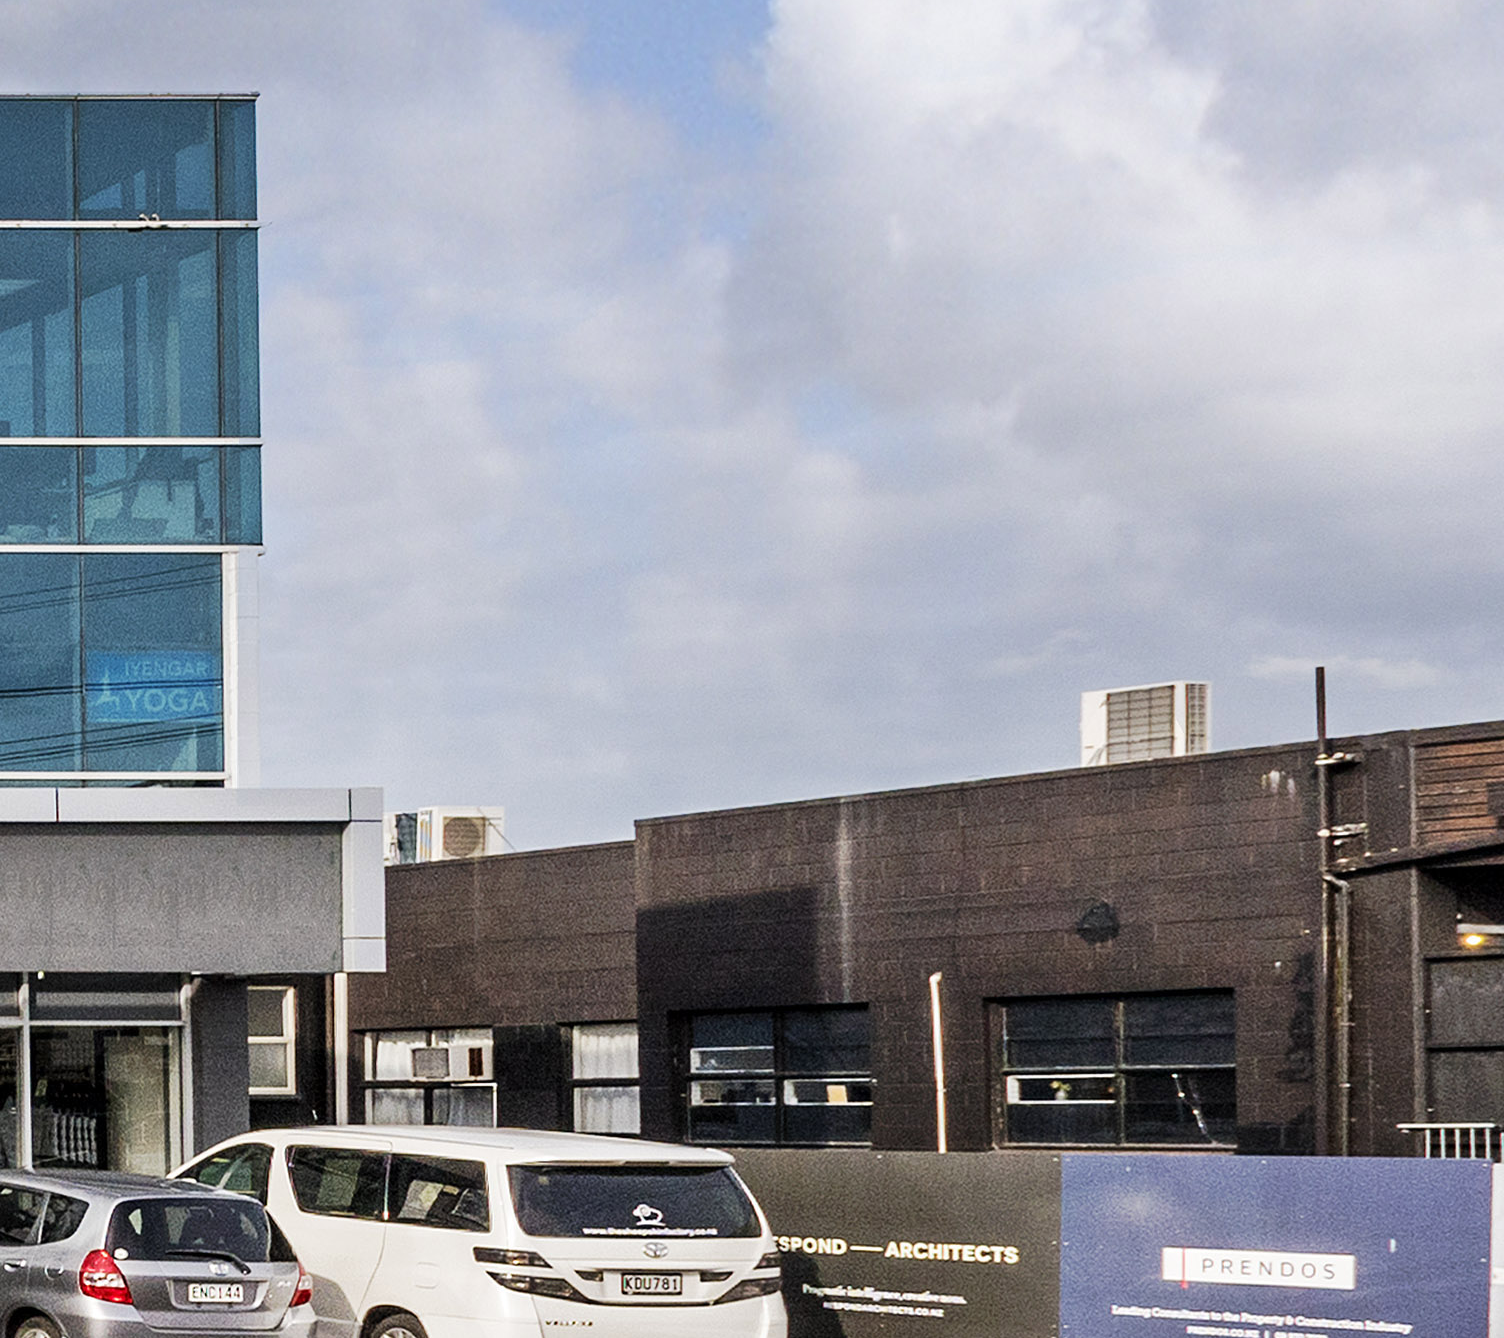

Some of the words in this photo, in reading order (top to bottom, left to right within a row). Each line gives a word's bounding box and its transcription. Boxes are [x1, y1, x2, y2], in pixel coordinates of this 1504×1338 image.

[125, 660, 209, 678] IYENGAR
[125, 688, 209, 712] YOGA
[884, 1240, 1021, 1265] ARCHITECTS
[1201, 1257, 1336, 1280] PRENDOS
[624, 1276, 678, 1291] KDU781
